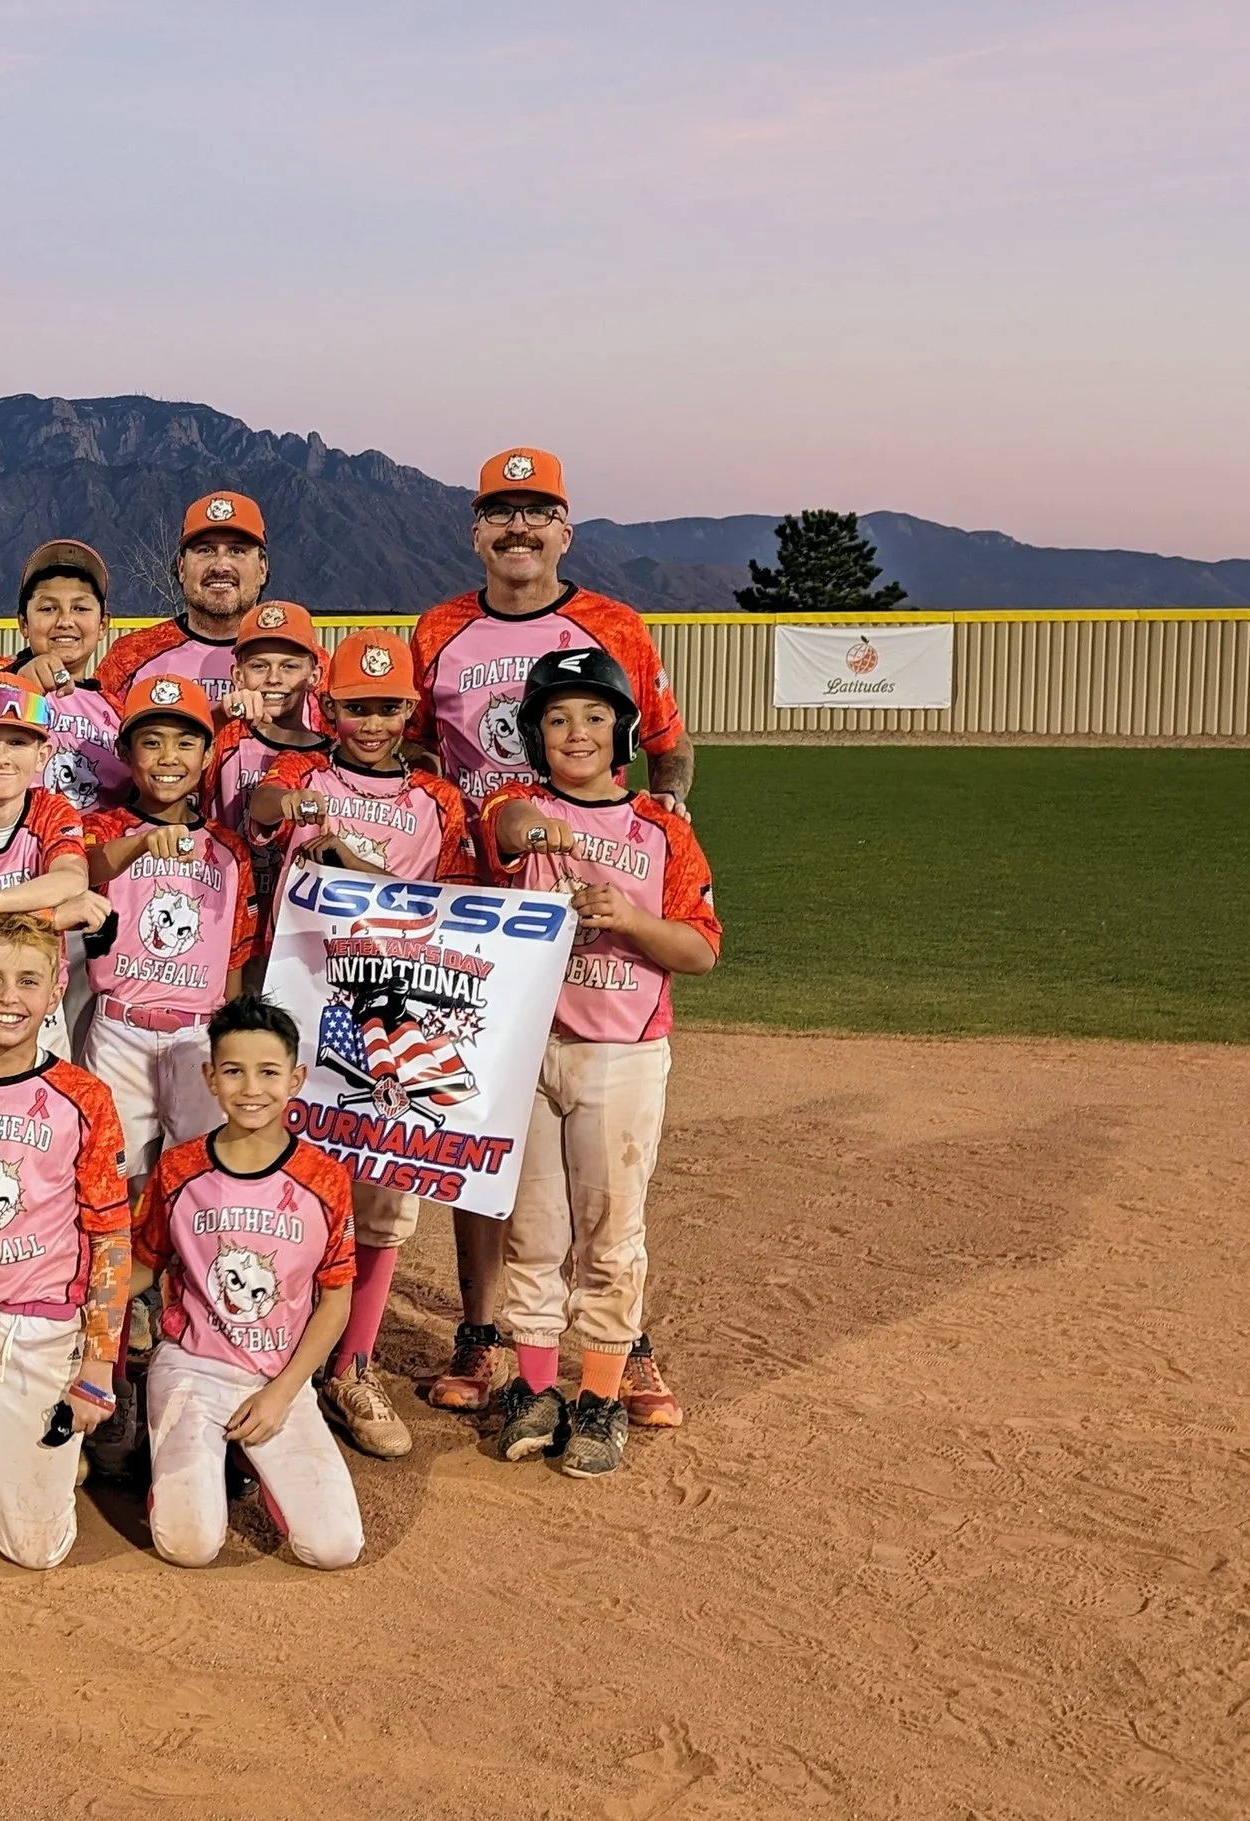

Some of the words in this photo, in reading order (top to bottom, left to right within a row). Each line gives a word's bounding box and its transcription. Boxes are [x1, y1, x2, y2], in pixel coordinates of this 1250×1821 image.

[822, 677, 896, 695] Latitudes
[114, 953, 210, 989] BASEBALL
[325, 956, 489, 1008] INVITATIONAL
[443, 948, 495, 979] DAY
[282, 1098, 515, 1175] OURNAMENT
[193, 1206, 305, 1245] GOATHEAD
